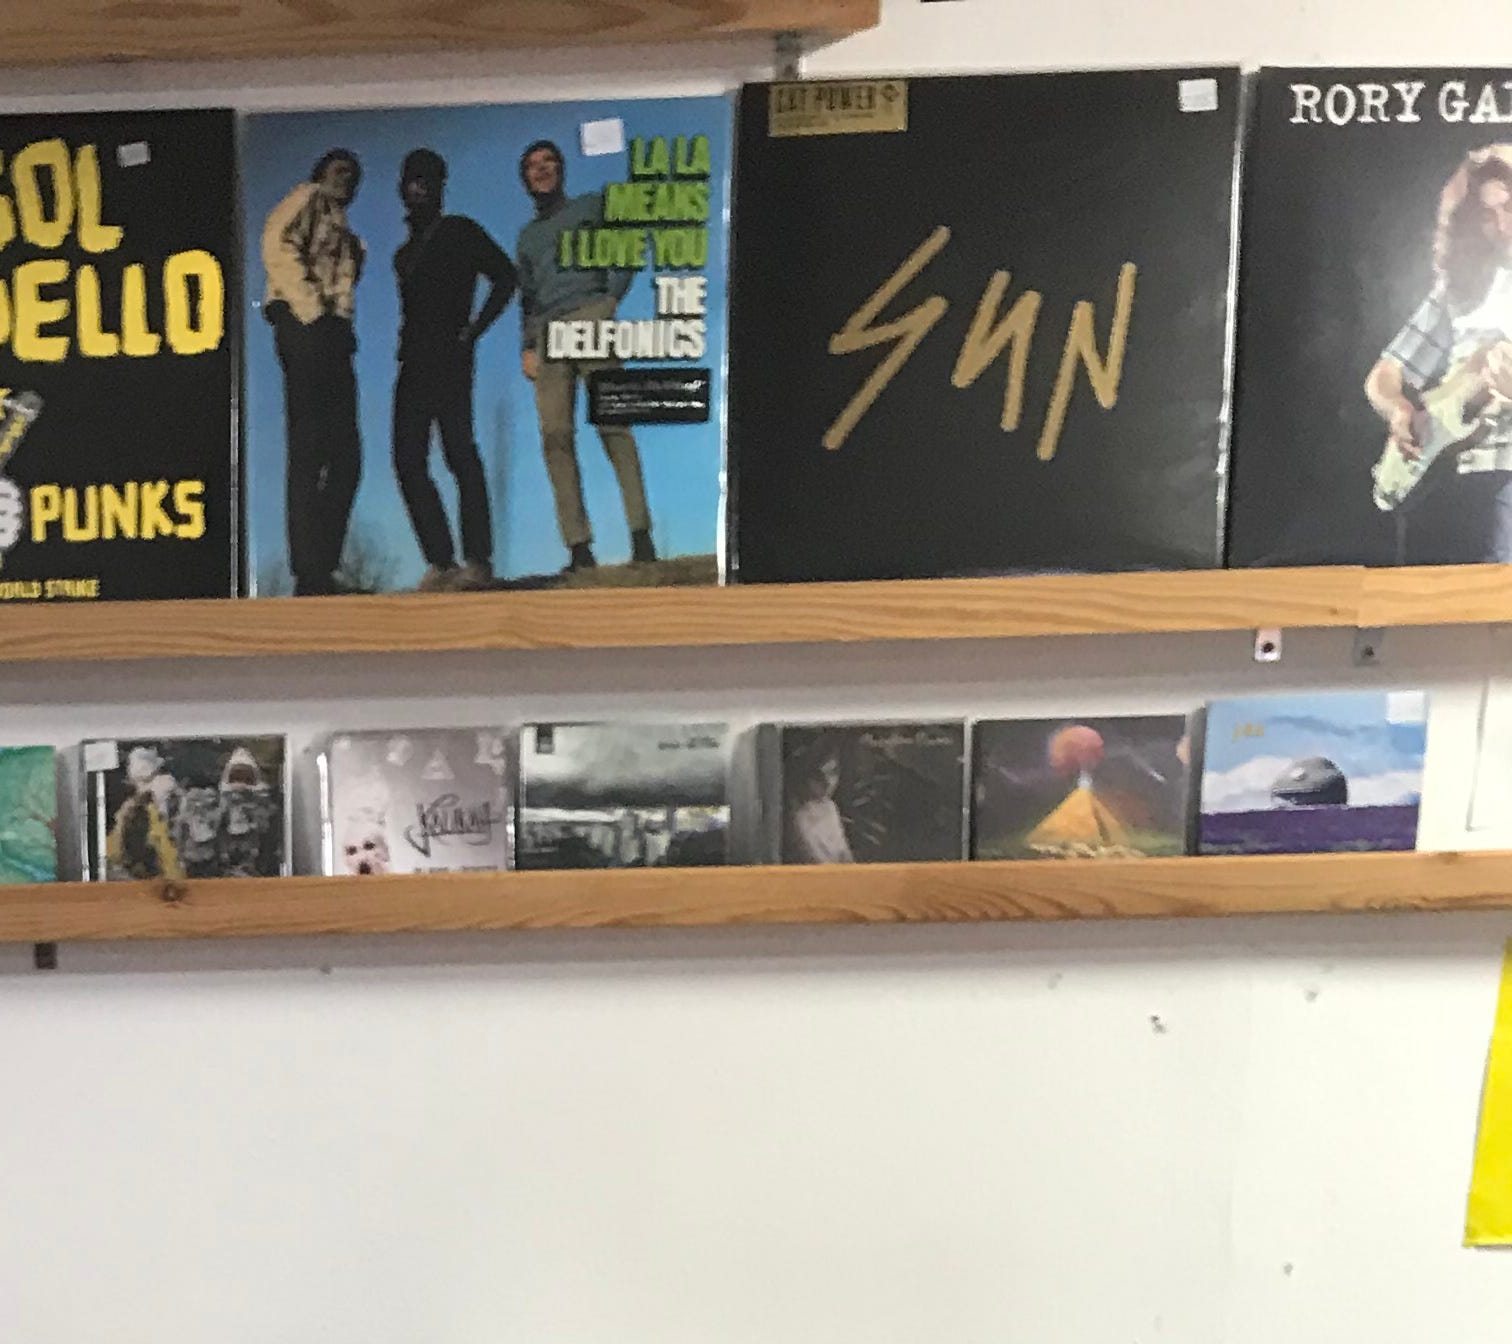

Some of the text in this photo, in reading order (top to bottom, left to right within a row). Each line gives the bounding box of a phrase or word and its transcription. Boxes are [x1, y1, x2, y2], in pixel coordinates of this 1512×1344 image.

[1289, 81, 1426, 125] RORY
[632, 134, 709, 175] LA LA
[604, 182, 709, 221] MEANS
[577, 229, 646, 268] LOVE
[653, 228, 708, 268] YOU
[655, 276, 707, 315] THE
[547, 319, 706, 359] DELFONICS
[821, 224, 1138, 461] SUN
[29, 480, 206, 543] PUNKS
